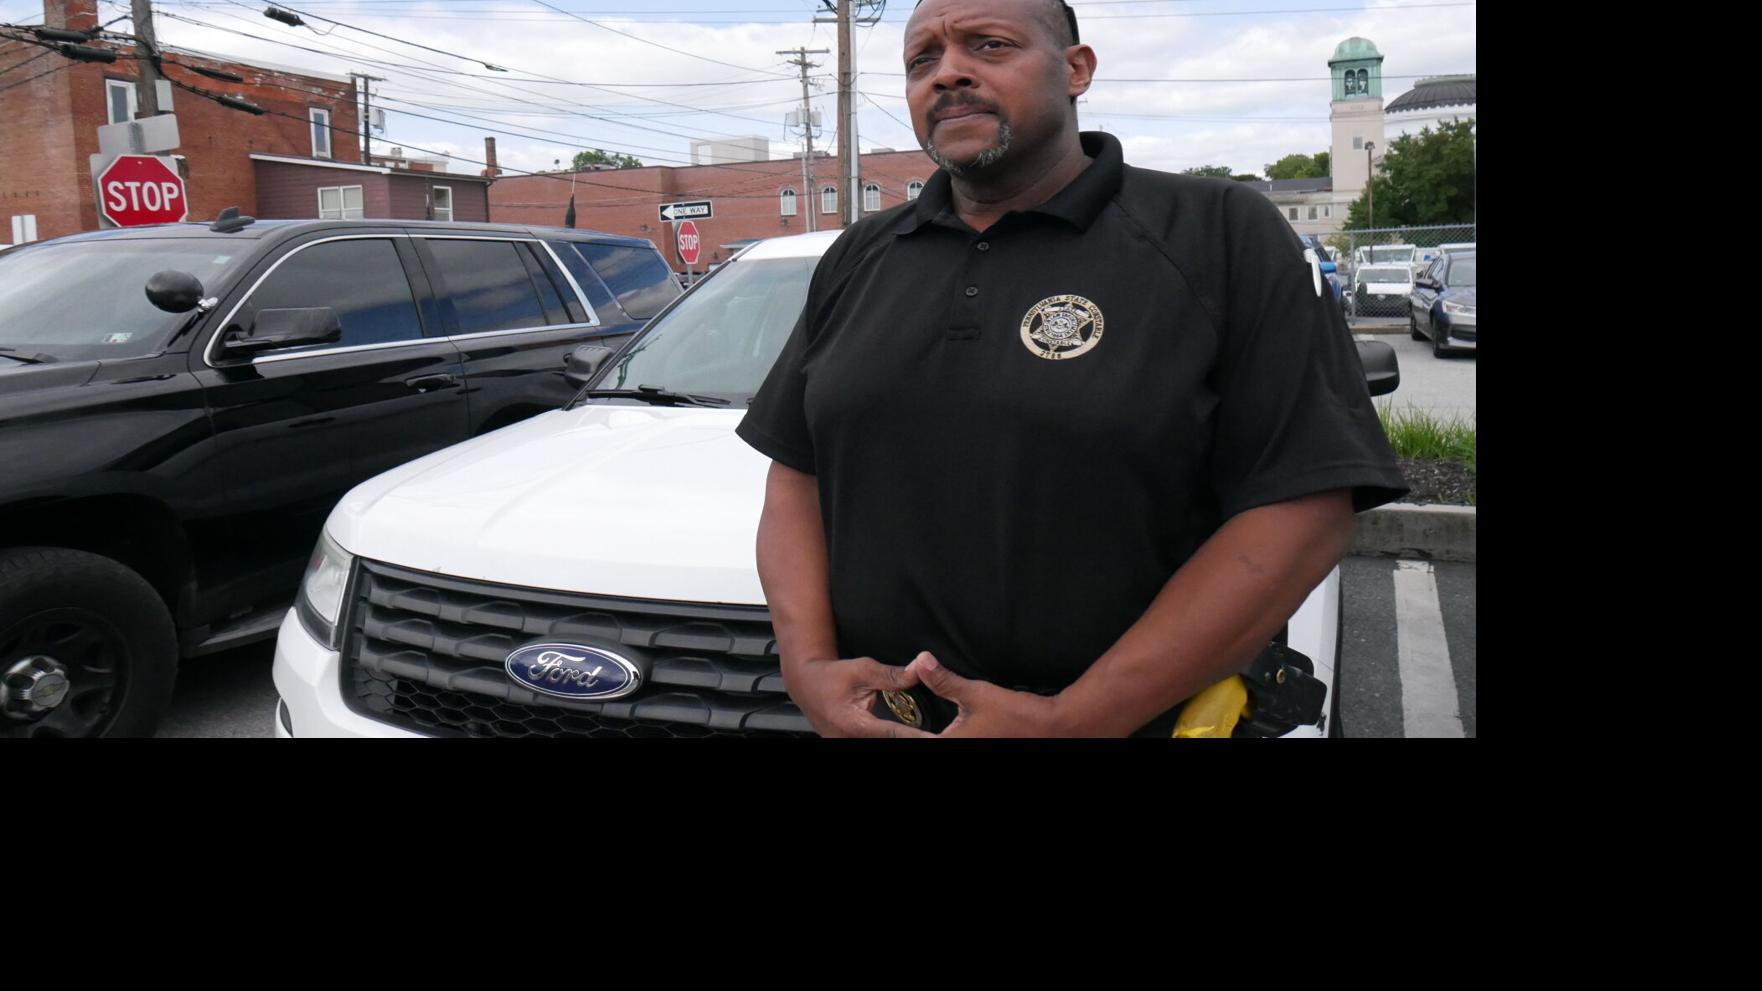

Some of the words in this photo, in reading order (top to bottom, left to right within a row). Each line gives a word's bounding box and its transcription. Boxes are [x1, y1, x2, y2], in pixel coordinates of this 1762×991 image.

[107, 180, 179, 212] STOP
[680, 234, 698, 250] STOP
[527, 650, 603, 688] Ford
